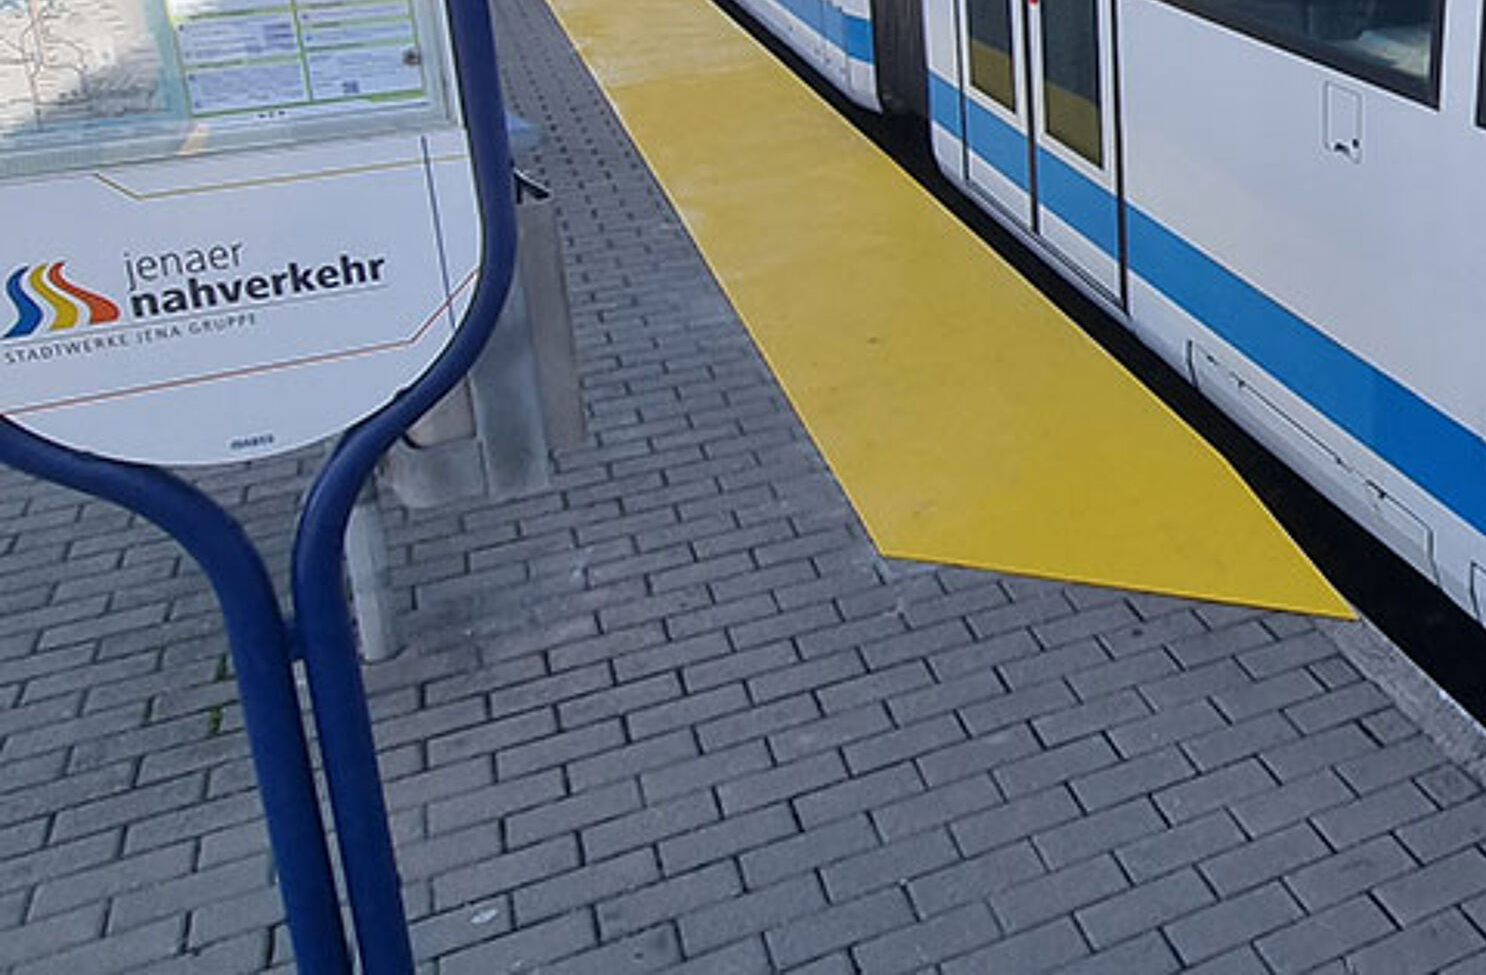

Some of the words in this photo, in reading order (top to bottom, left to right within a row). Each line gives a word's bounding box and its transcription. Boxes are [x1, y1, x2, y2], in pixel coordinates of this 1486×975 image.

[123, 242, 243, 292] jenaer
[130, 254, 386, 318] nahverkehr
[4, 335, 128, 364] STADTWERKE
[136, 326, 181, 344] JENA
[188, 313, 257, 336] GRUPPE
